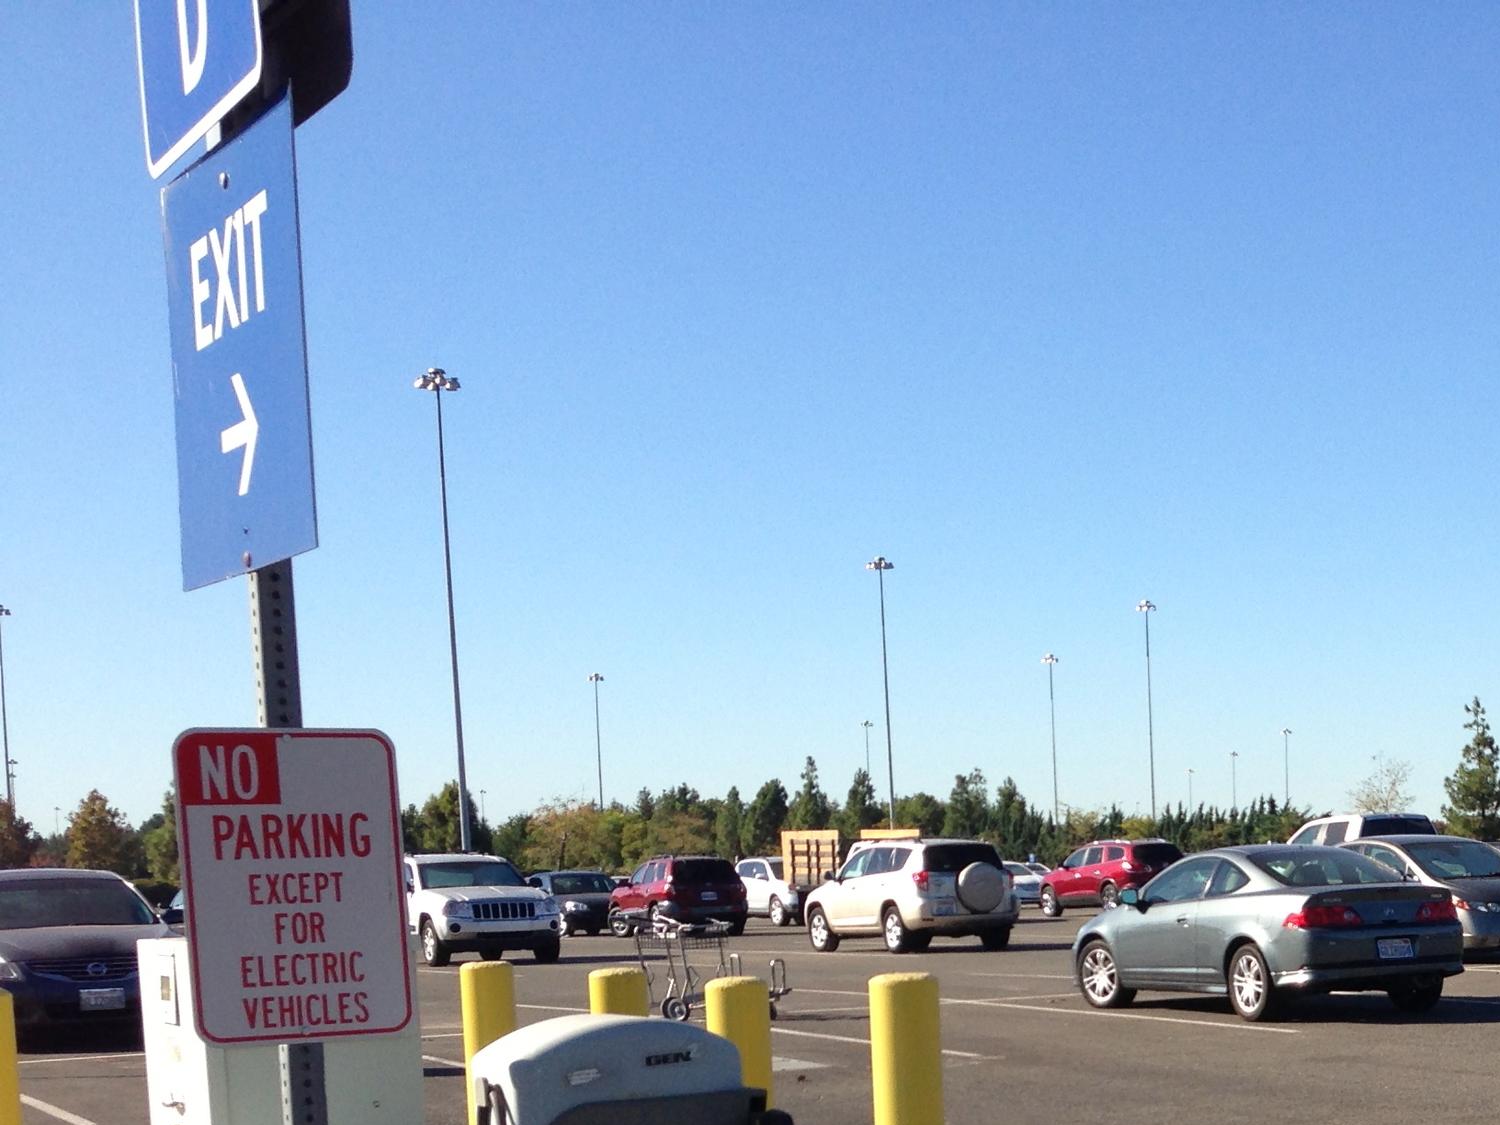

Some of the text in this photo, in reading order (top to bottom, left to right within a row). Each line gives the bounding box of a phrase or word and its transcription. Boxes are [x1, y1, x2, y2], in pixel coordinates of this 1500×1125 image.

[190, 189, 267, 351] EXIT
[198, 744, 260, 800] NO
[212, 812, 372, 860] PARKING
[248, 872, 343, 905] EXCEPT
[274, 912, 326, 944] FOR
[240, 951, 365, 988] ELECTRIC
[242, 992, 370, 1028] VEHICLES
